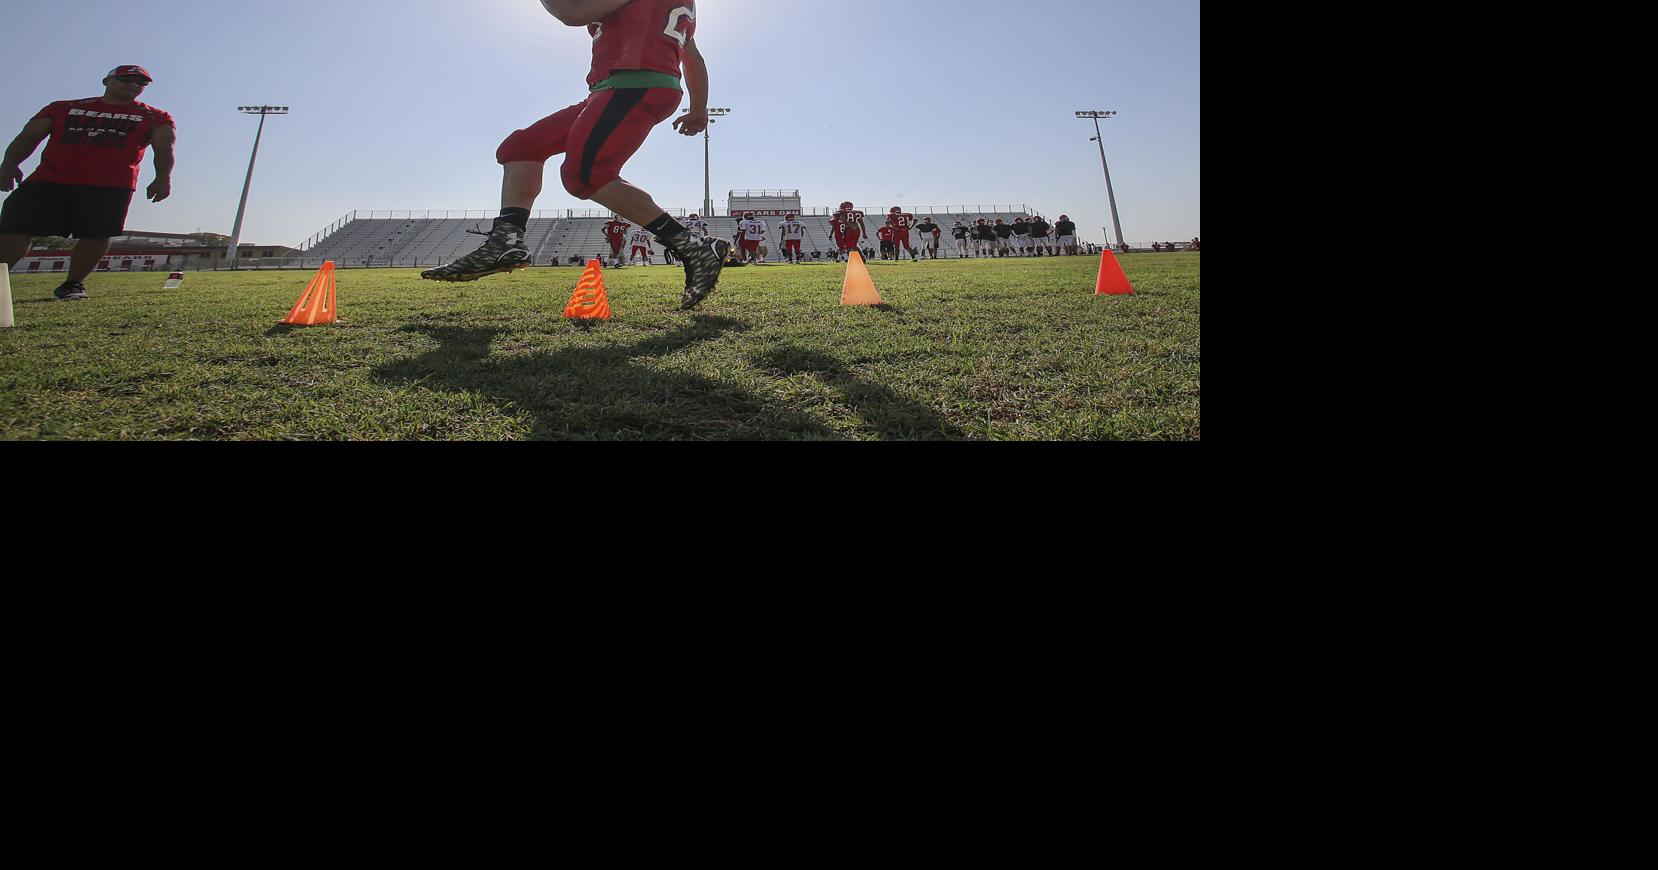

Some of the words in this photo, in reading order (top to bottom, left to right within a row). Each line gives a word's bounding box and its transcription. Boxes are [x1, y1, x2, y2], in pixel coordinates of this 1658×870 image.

[68, 108, 144, 122] BEARS
[749, 224, 763, 235] 31
[787, 223, 801, 234] 17
[634, 233, 647, 243] 30
